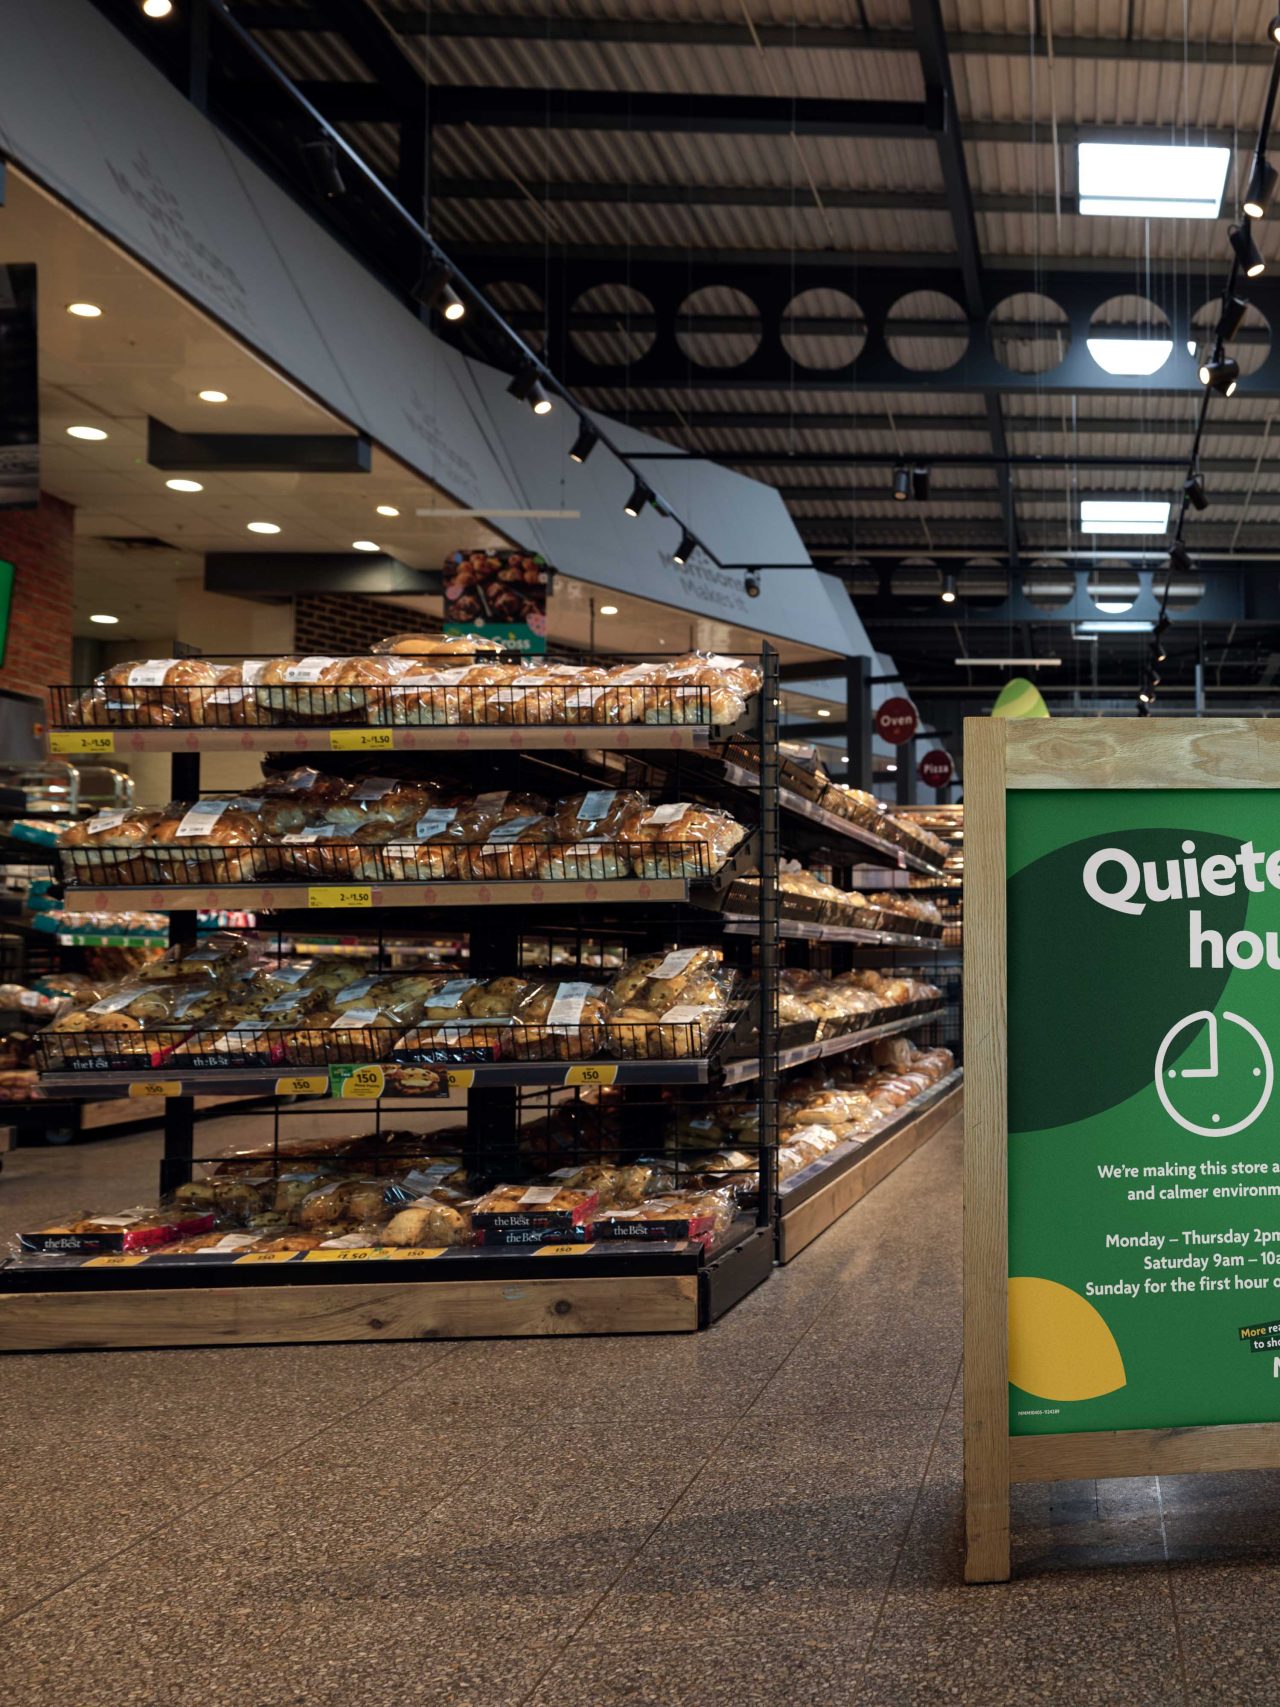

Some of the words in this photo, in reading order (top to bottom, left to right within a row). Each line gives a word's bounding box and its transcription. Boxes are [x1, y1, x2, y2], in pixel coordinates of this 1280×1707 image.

[881, 715, 913, 727] Oven
[923, 762, 949, 773] Pizza
[357, 1073, 377, 1083] 150
[583, 1071, 599, 1079] 150
[292, 1081, 310, 1090] 150
[1098, 1164, 1140, 1179] We're
[1143, 1162, 1197, 1180] making
[1200, 1160, 1228, 1176] this
[1231, 1161, 1269, 1175] store
[1272, 1163, 1280, 1174] a
[1127, 1184, 1155, 1201] and
[1159, 1183, 1209, 1199] calmer
[1105, 1232, 1166, 1250] Monday
[1181, 1229, 1250, 1247] Thursday
[1143, 1253, 1209, 1272] Saturday
[1213, 1253, 1245, 1268] 9am
[1086, 1280, 1141, 1298] Sunday
[1143, 1278, 1167, 1293] for
[1171, 1277, 1196, 1292] the
[1200, 1276, 1231, 1291] first
[1235, 1274, 1269, 1289] hour
[1241, 1327, 1266, 1338] More
[1253, 1340, 1265, 1349] to
